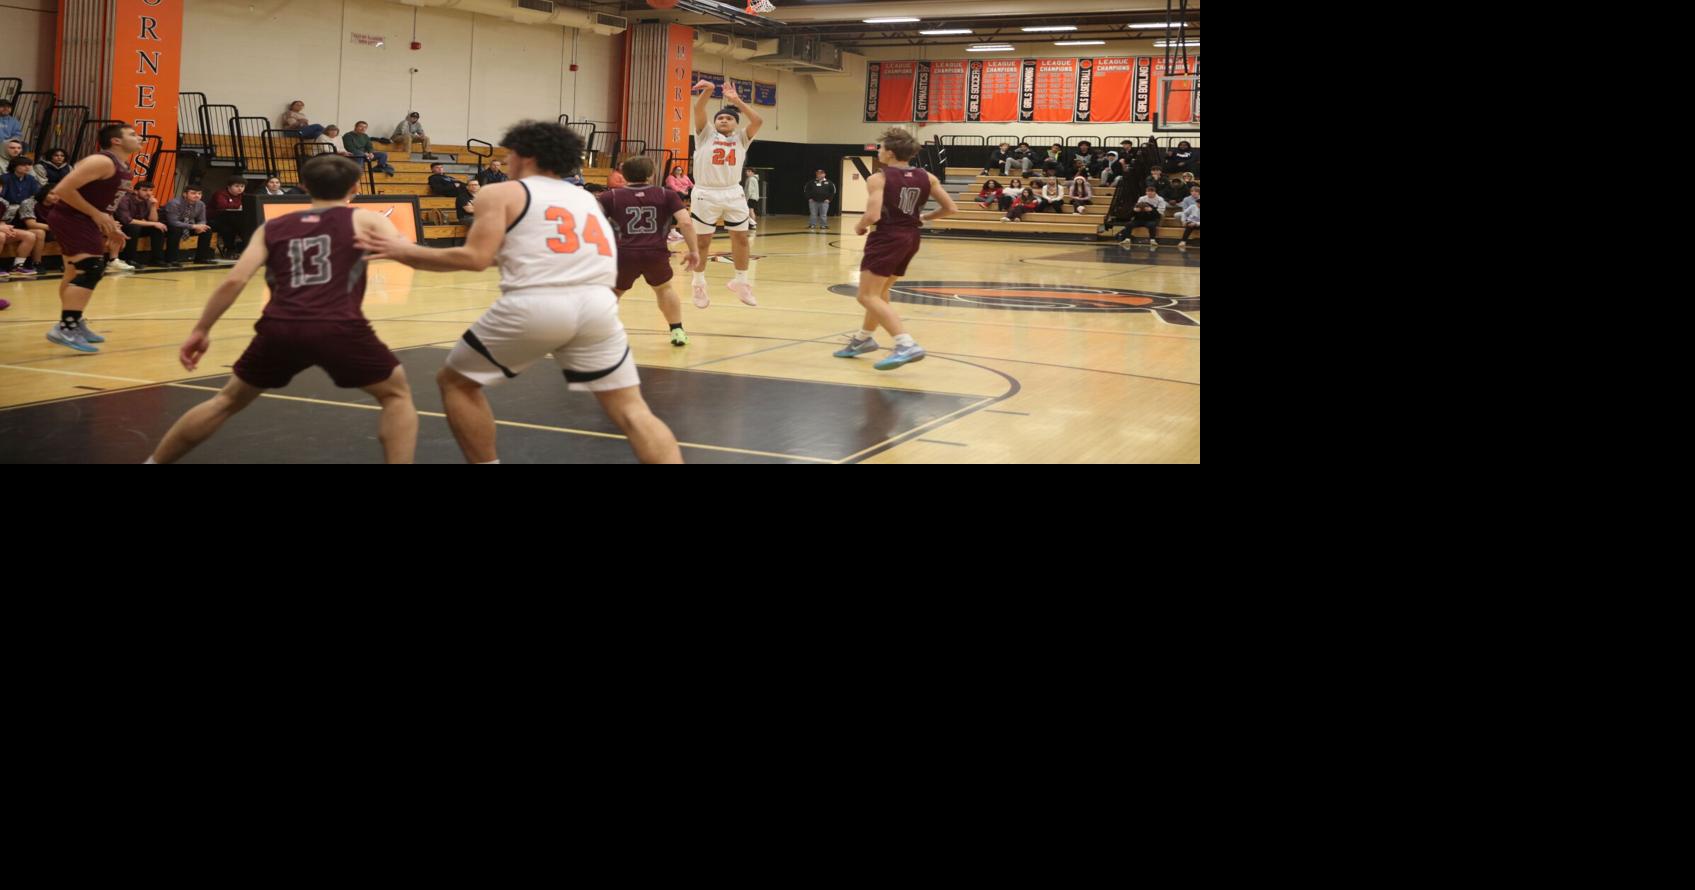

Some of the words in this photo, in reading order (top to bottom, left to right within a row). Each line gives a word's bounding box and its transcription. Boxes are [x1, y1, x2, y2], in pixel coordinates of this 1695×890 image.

[133, 0, 161, 177] RNETS
[918, 73, 928, 110] GYMNASTICS
[970, 70, 980, 94] SOCCER
[1024, 67, 1034, 92] SWIMMING
[1079, 70, 1090, 97] BASKETBALL
[1138, 66, 1148, 93] BOWLING
[970, 95, 979, 112] GIRLS
[1023, 93, 1032, 108] GIRLS
[1079, 98, 1088, 111] GIRLS
[1137, 95, 1147, 112] GIRLS
[712, 148, 736, 166] 24
[898, 186, 921, 215] 10
[544, 206, 613, 257] 34
[625, 206, 657, 234] 23
[287, 234, 332, 288] 13
